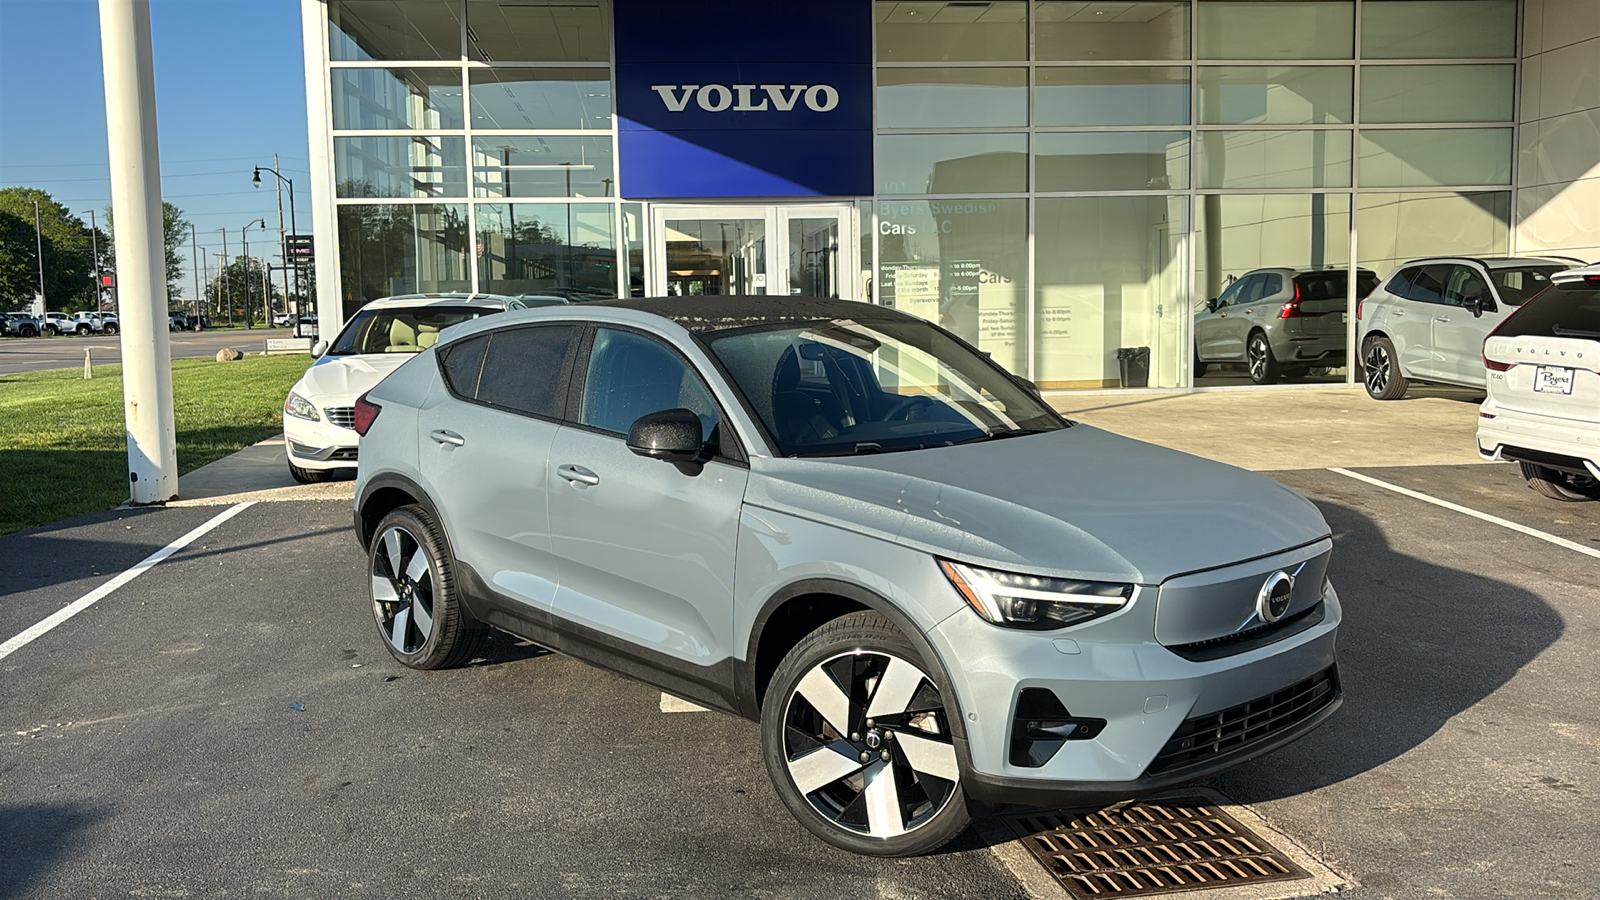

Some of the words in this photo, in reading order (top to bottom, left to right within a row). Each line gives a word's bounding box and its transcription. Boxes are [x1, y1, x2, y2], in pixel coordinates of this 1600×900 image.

[651, 84, 839, 112] VOLVO
[880, 202, 924, 219] Byers
[931, 200, 996, 215] Swedish
[879, 221, 916, 235] Cars
[1516, 347, 1583, 359] VOLVO
[1540, 372, 1569, 385] Byers
